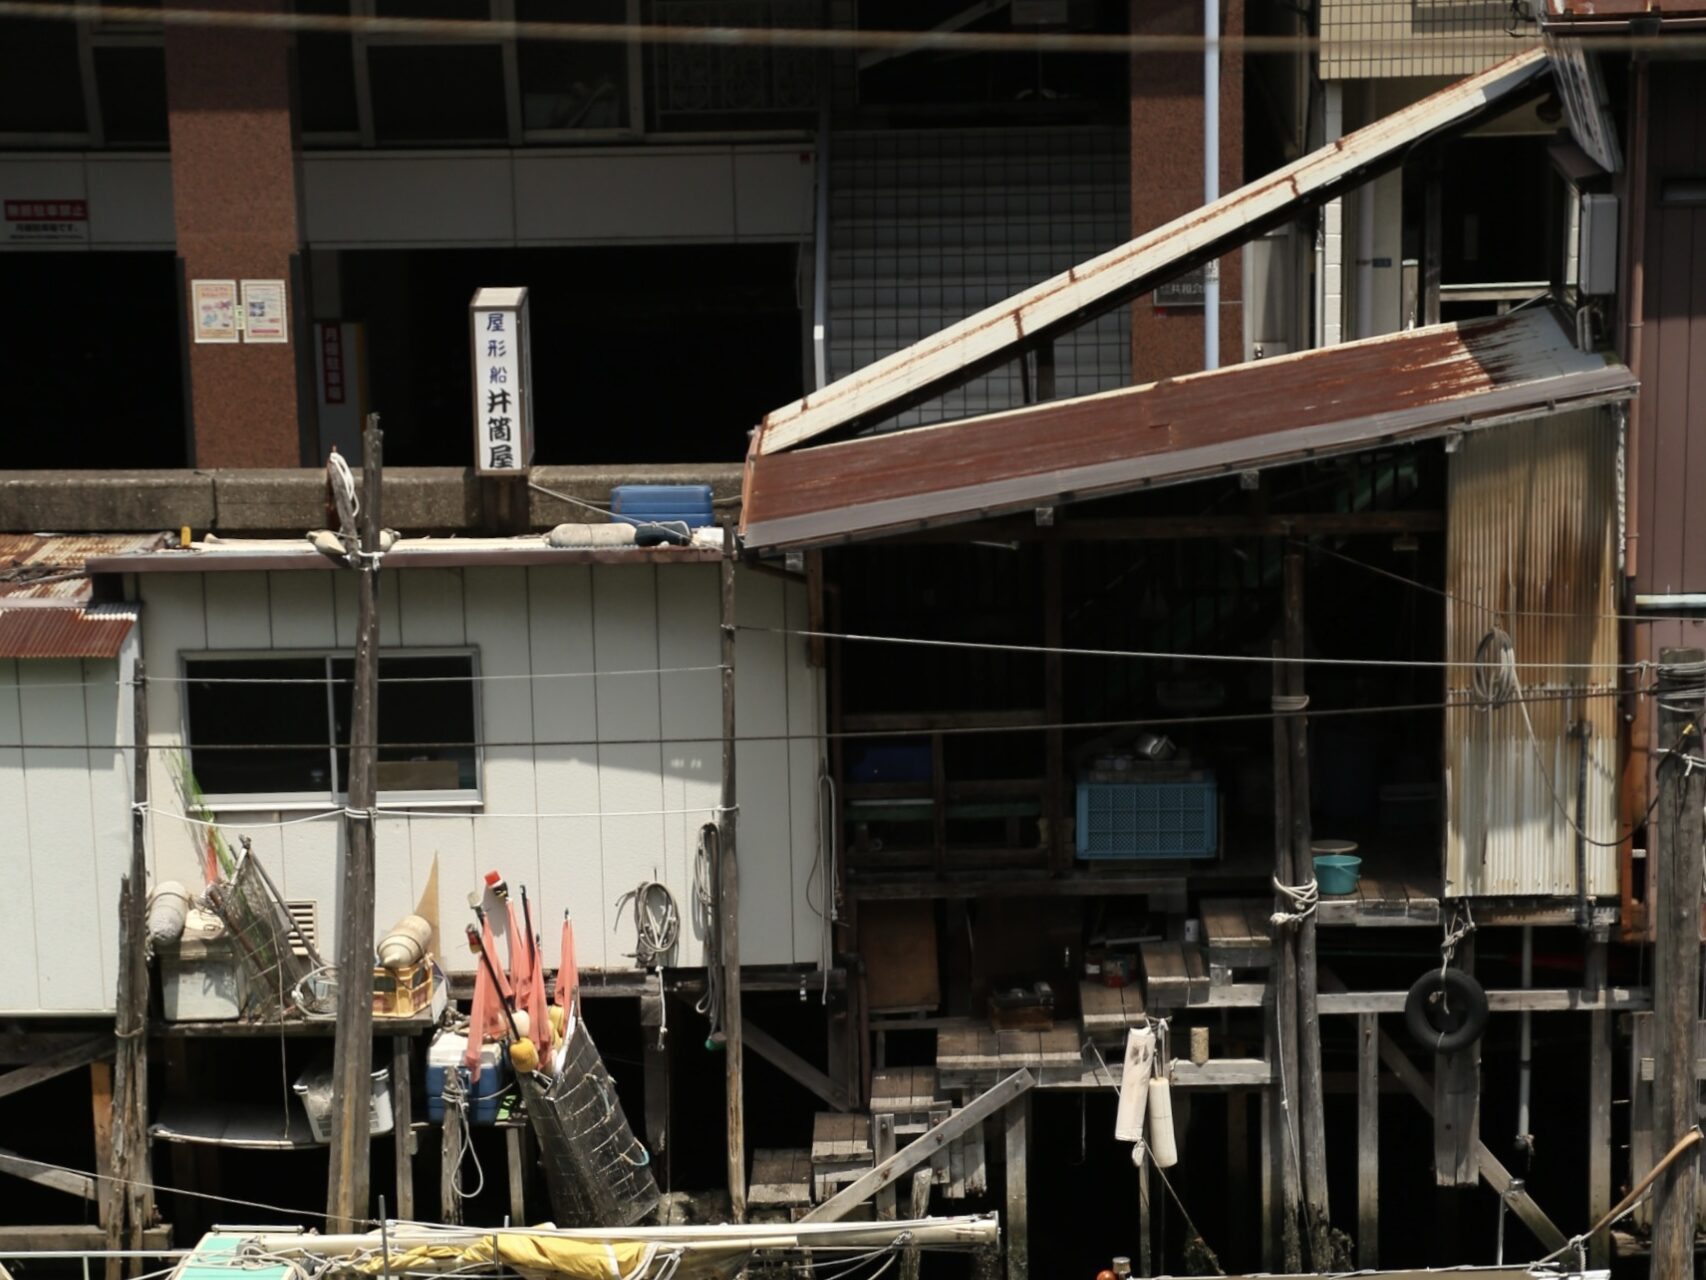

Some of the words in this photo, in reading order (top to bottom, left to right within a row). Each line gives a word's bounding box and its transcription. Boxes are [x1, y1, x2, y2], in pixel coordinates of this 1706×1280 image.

[487, 313, 508, 384] 屋形船
[488, 388, 514, 470] 井筒屋
